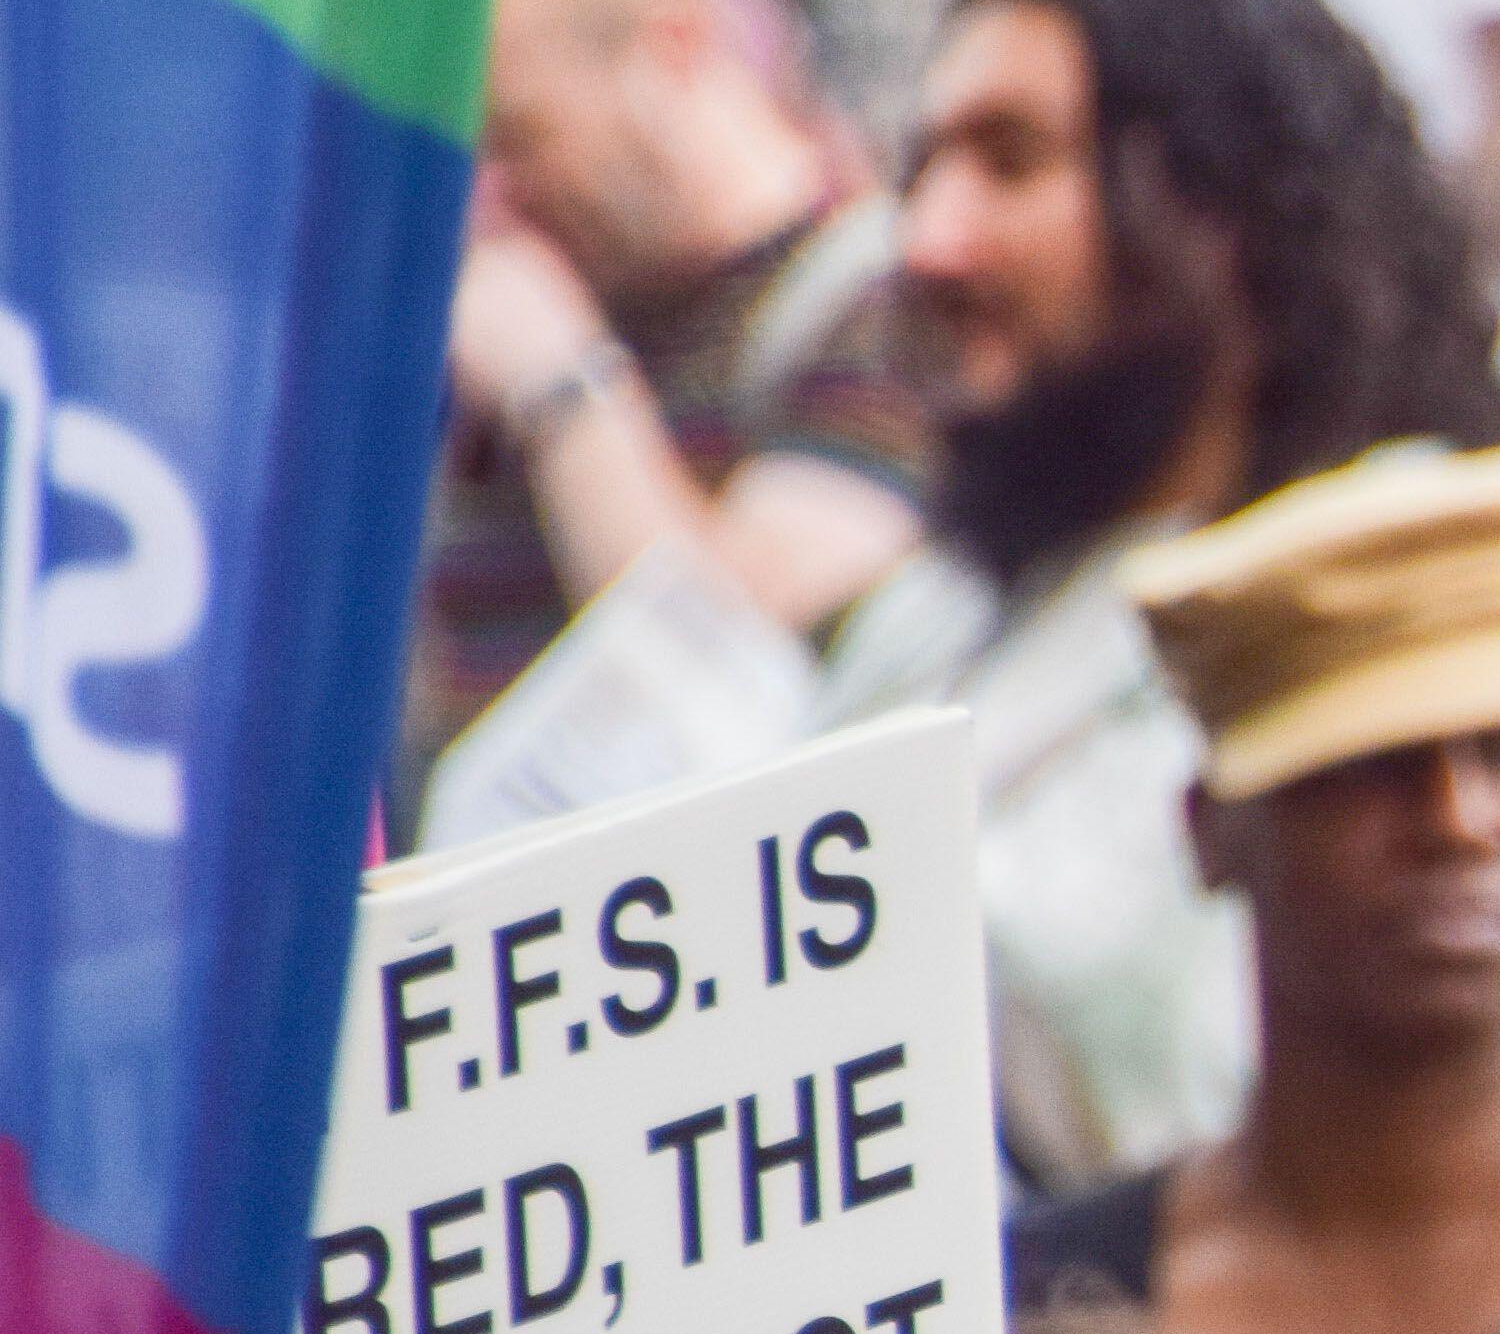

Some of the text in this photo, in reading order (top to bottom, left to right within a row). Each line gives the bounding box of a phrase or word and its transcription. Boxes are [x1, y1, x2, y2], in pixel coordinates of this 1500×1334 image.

[379, 809, 877, 1115] F.F.S. IS
[645, 1042, 914, 1266] THE
